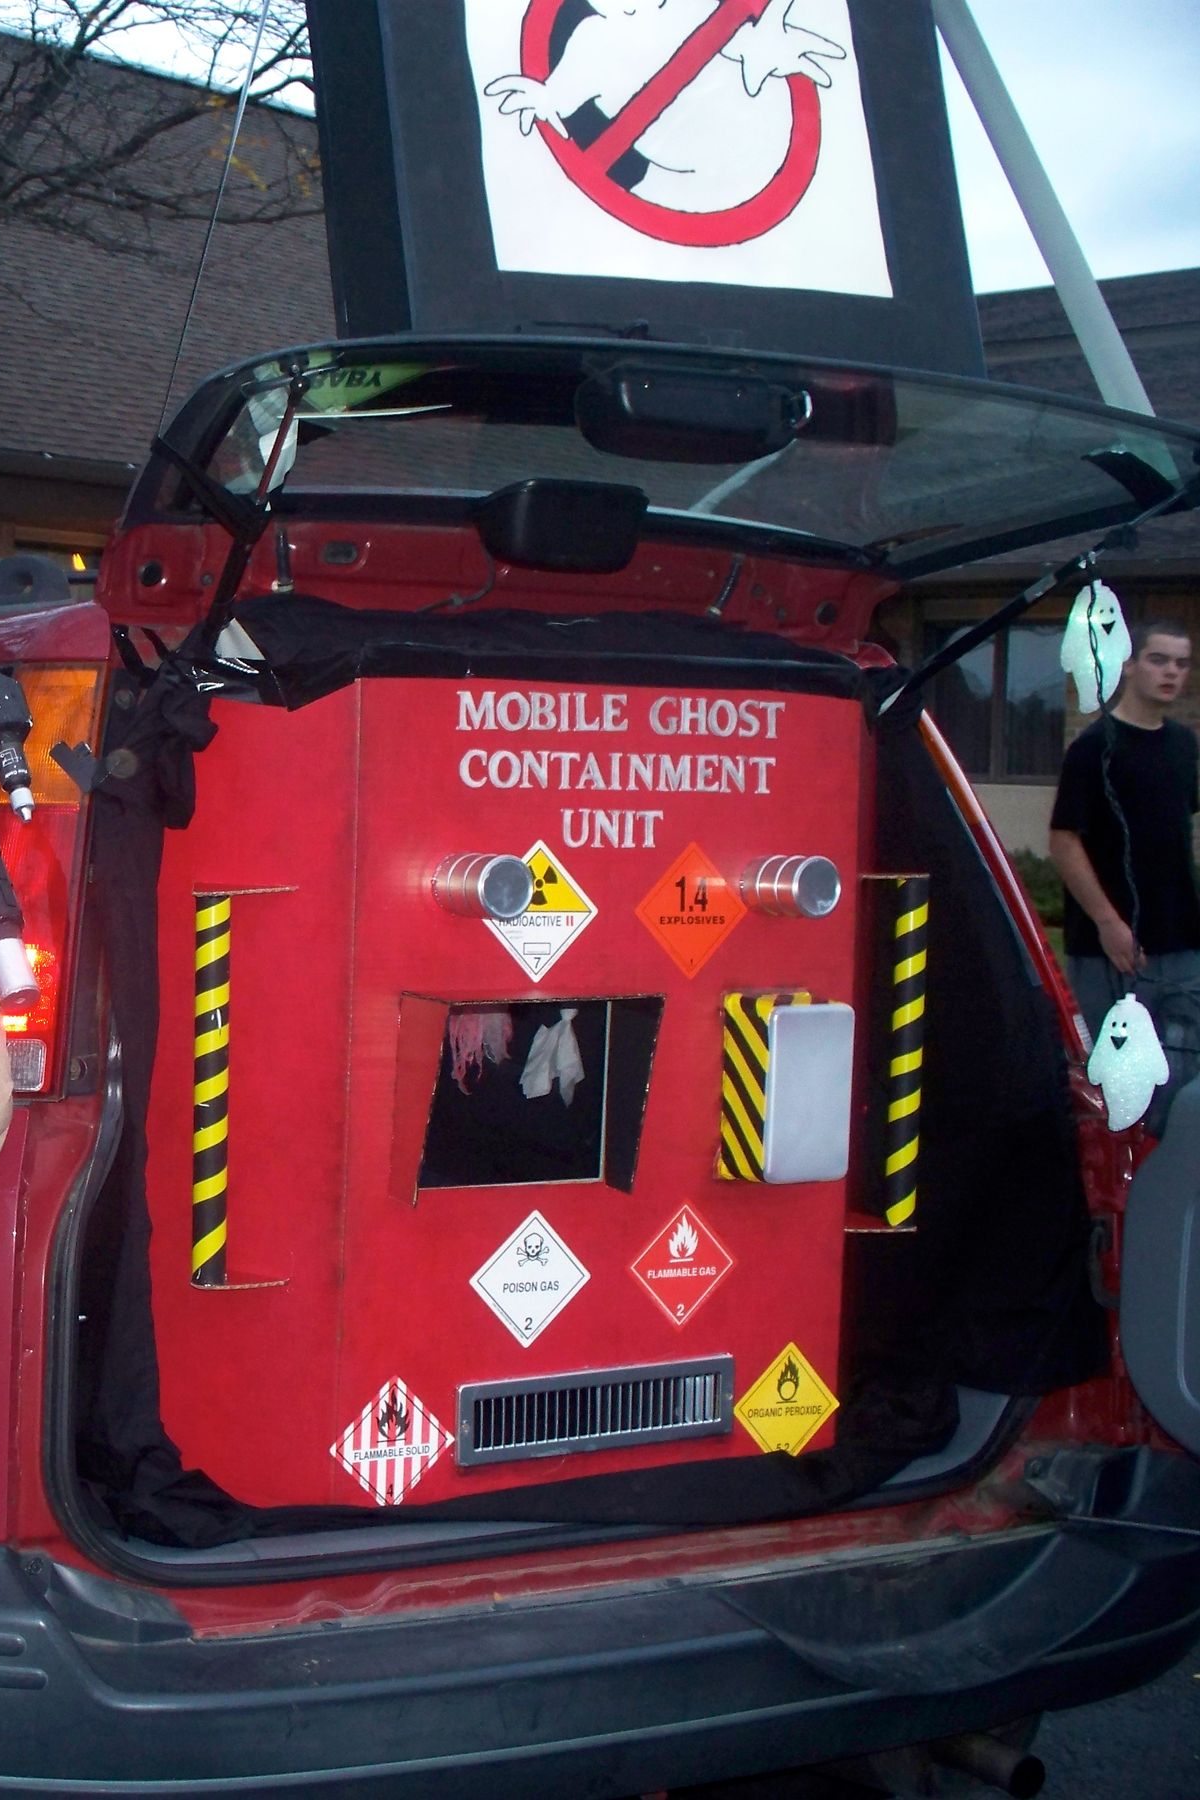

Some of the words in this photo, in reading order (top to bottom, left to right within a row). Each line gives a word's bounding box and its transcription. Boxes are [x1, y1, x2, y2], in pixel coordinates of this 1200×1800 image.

[456, 690, 629, 732] MOBILE
[649, 695, 786, 739] GHOST
[458, 749, 777, 794] CONTAINMENT
[560, 807, 665, 849] UNIT
[675, 876, 708, 912] 1.4
[499, 915, 562, 927] RADIOACTIVE
[566, 915, 574, 927] II
[659, 915, 726, 925] EXPLOSIVES
[534, 957, 542, 969] 7
[647, 1267, 698, 1279] FLAMMABLE
[699, 1266, 717, 1276] GAS
[502, 1282, 538, 1294] POISON
[540, 1280, 560, 1292] GAS
[676, 1303, 685, 1317] 2
[524, 1316, 533, 1331] 2
[747, 1407, 783, 1419] ORGANIC
[785, 1405, 822, 1416] PEROXIDE
[353, 1447, 405, 1460] FLAMMABLE
[405, 1444, 431, 1456] SOLID
[776, 1442, 790, 1451] 52
[386, 1483, 394, 1498] 4
